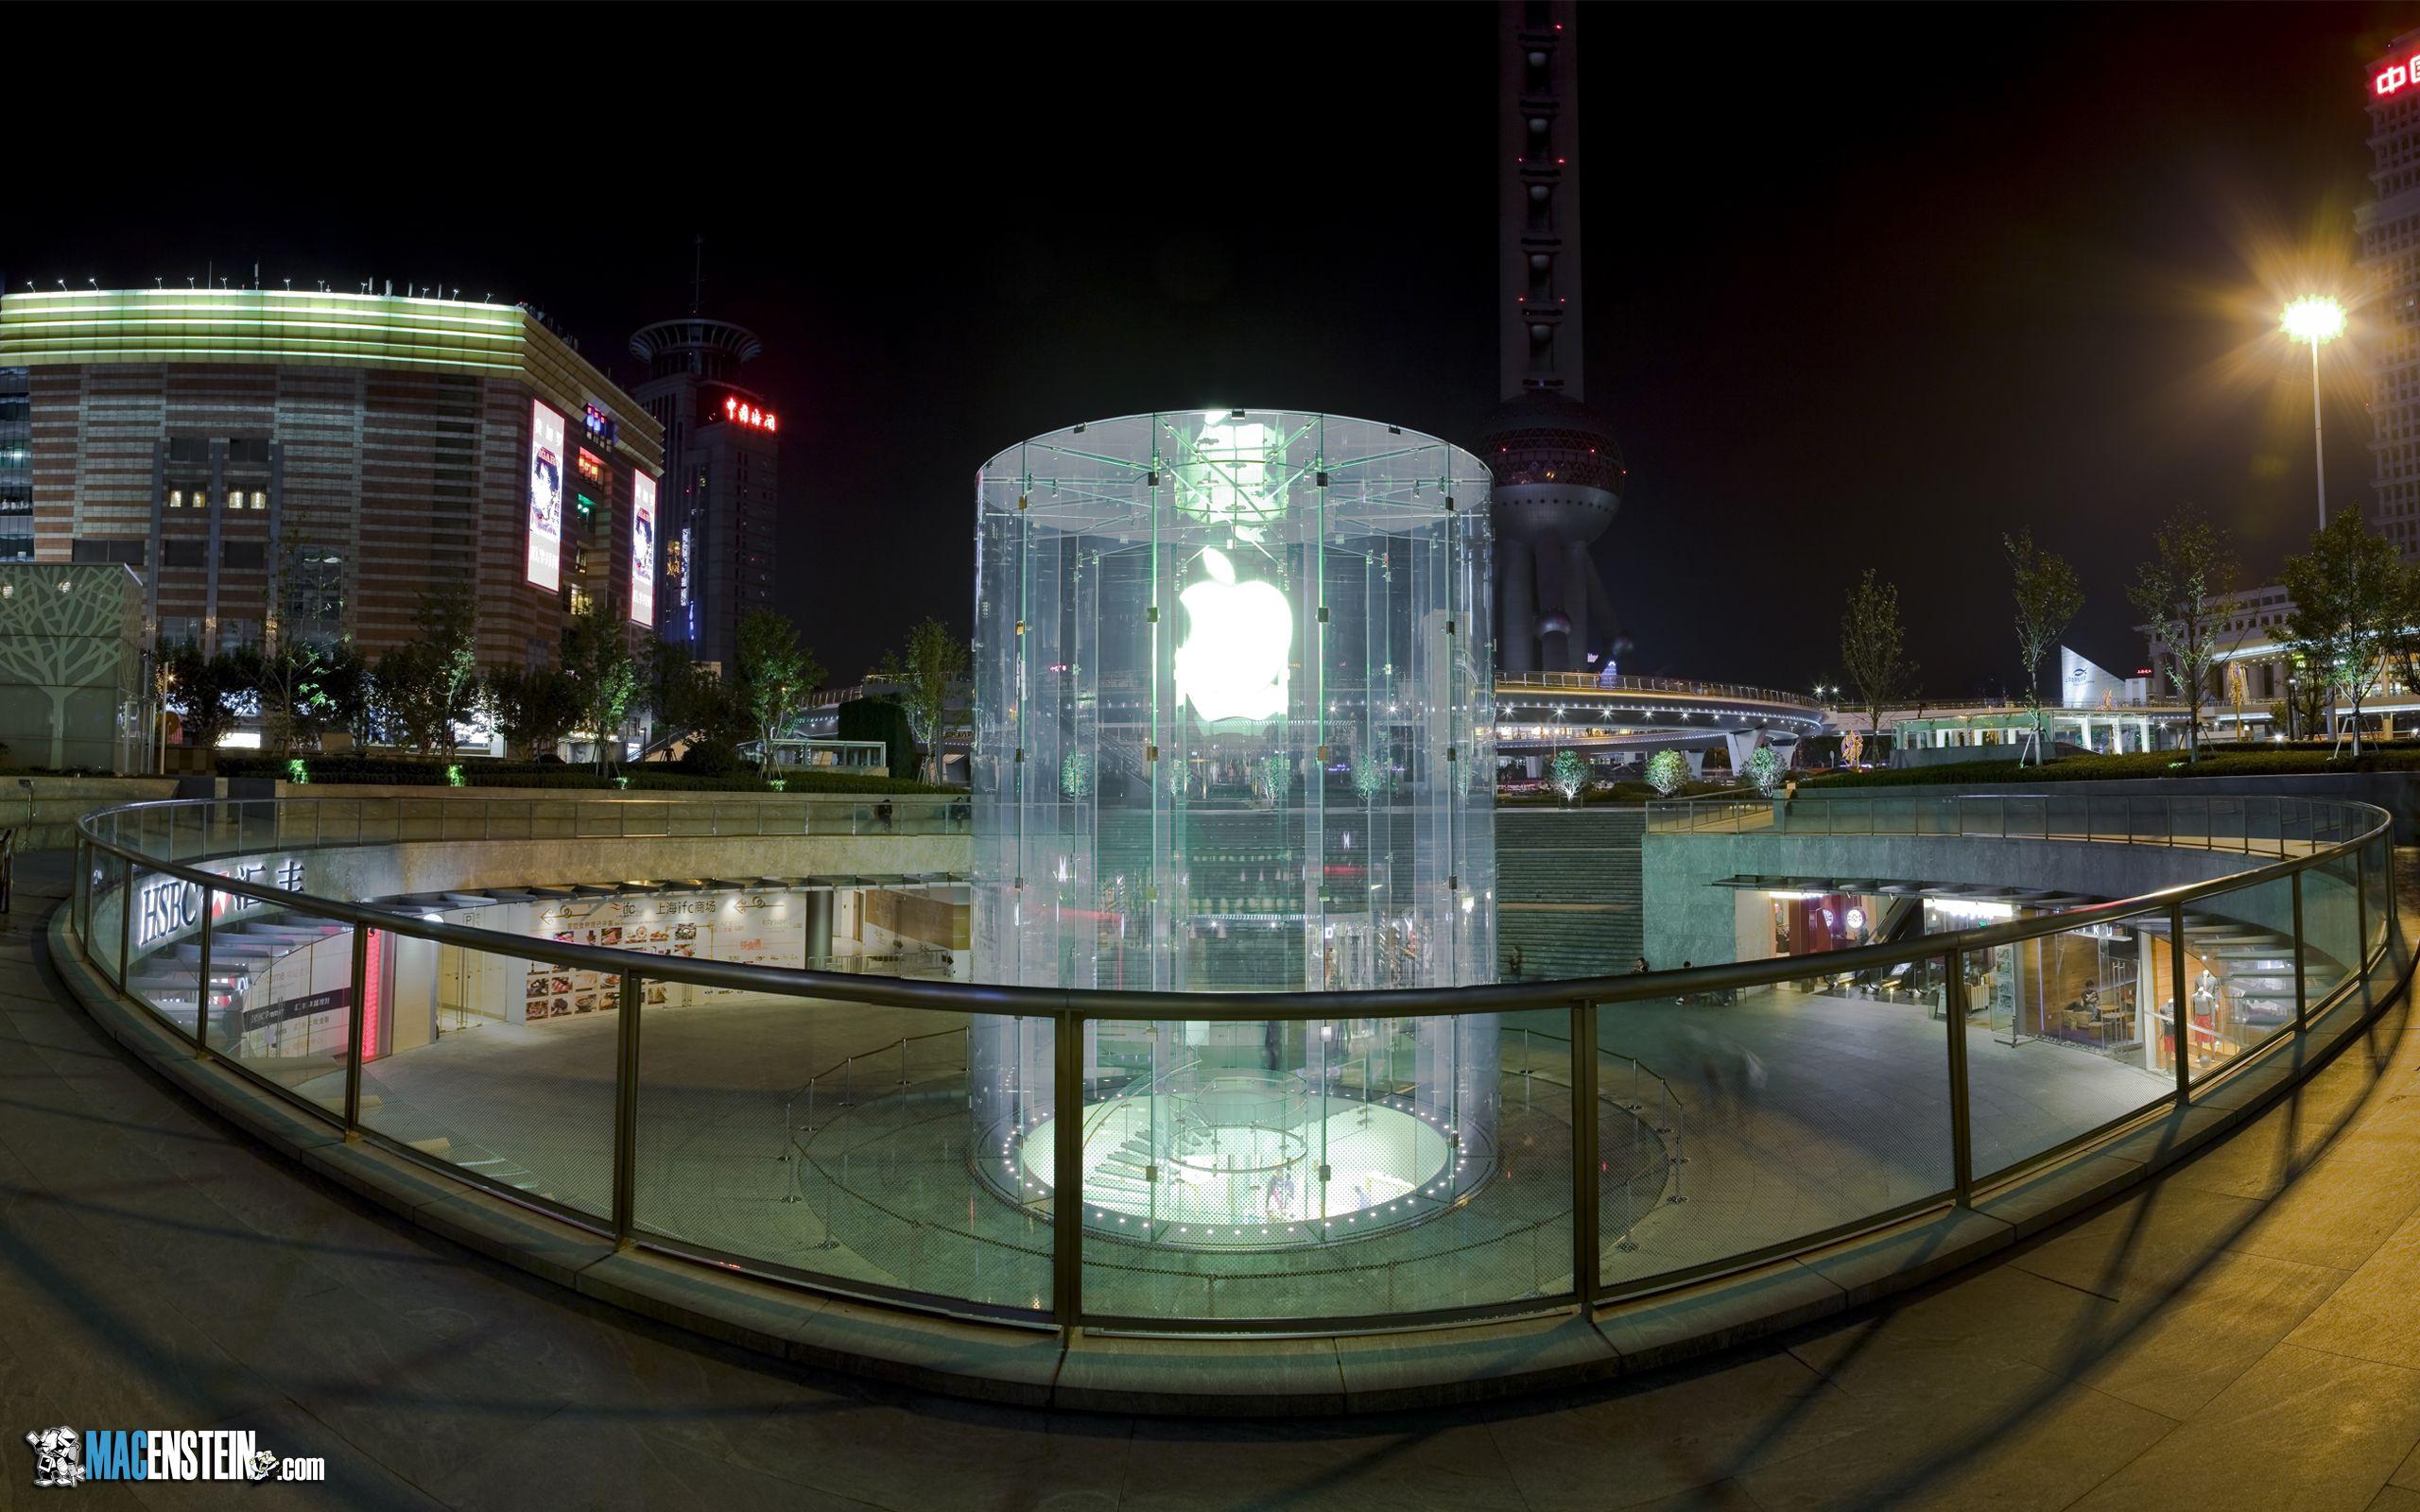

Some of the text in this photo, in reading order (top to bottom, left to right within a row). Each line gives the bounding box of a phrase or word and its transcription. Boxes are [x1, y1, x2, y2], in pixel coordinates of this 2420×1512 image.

[234, 861, 305, 911] 汇丰
[140, 880, 197, 945] HSBC
[622, 902, 636, 915] ifc
[656, 901, 717, 915] 上海ifc商场
